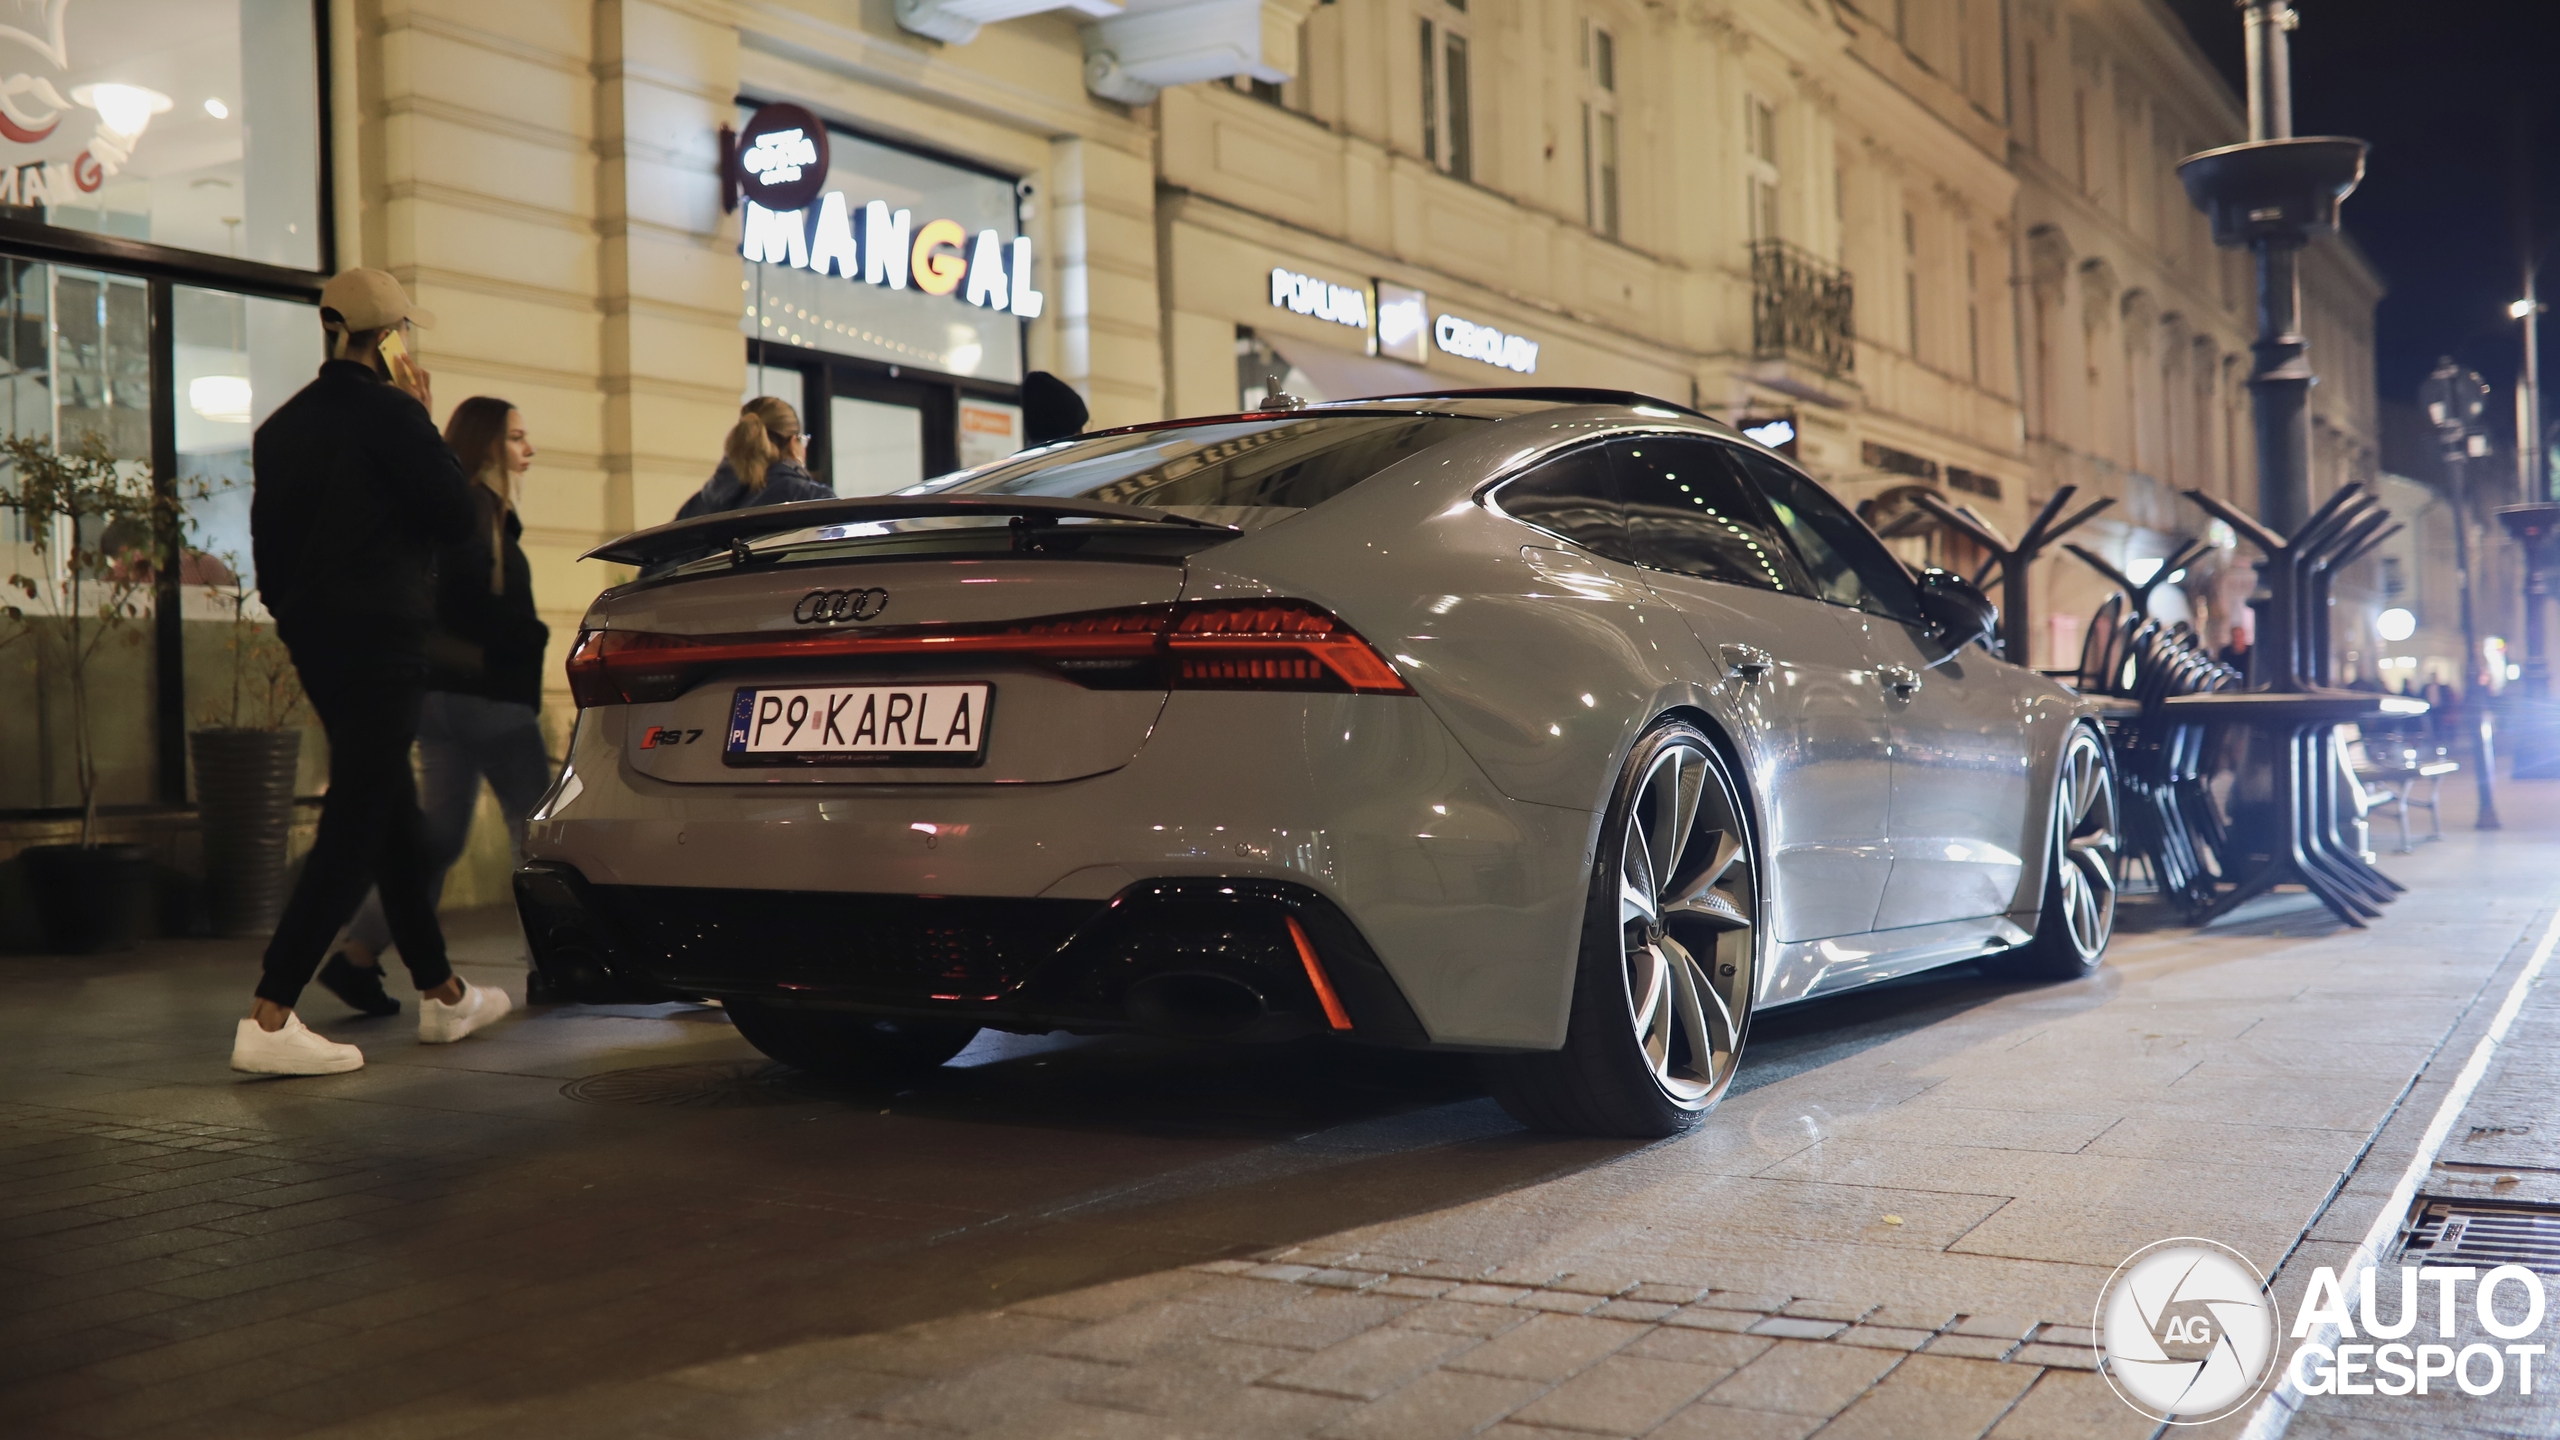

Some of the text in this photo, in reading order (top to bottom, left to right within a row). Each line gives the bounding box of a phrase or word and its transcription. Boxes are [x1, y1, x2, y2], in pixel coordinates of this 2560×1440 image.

[743, 191, 1043, 318] MANGAL
[732, 730, 746, 743] PL
[754, 692, 971, 746] P9 KARLA
